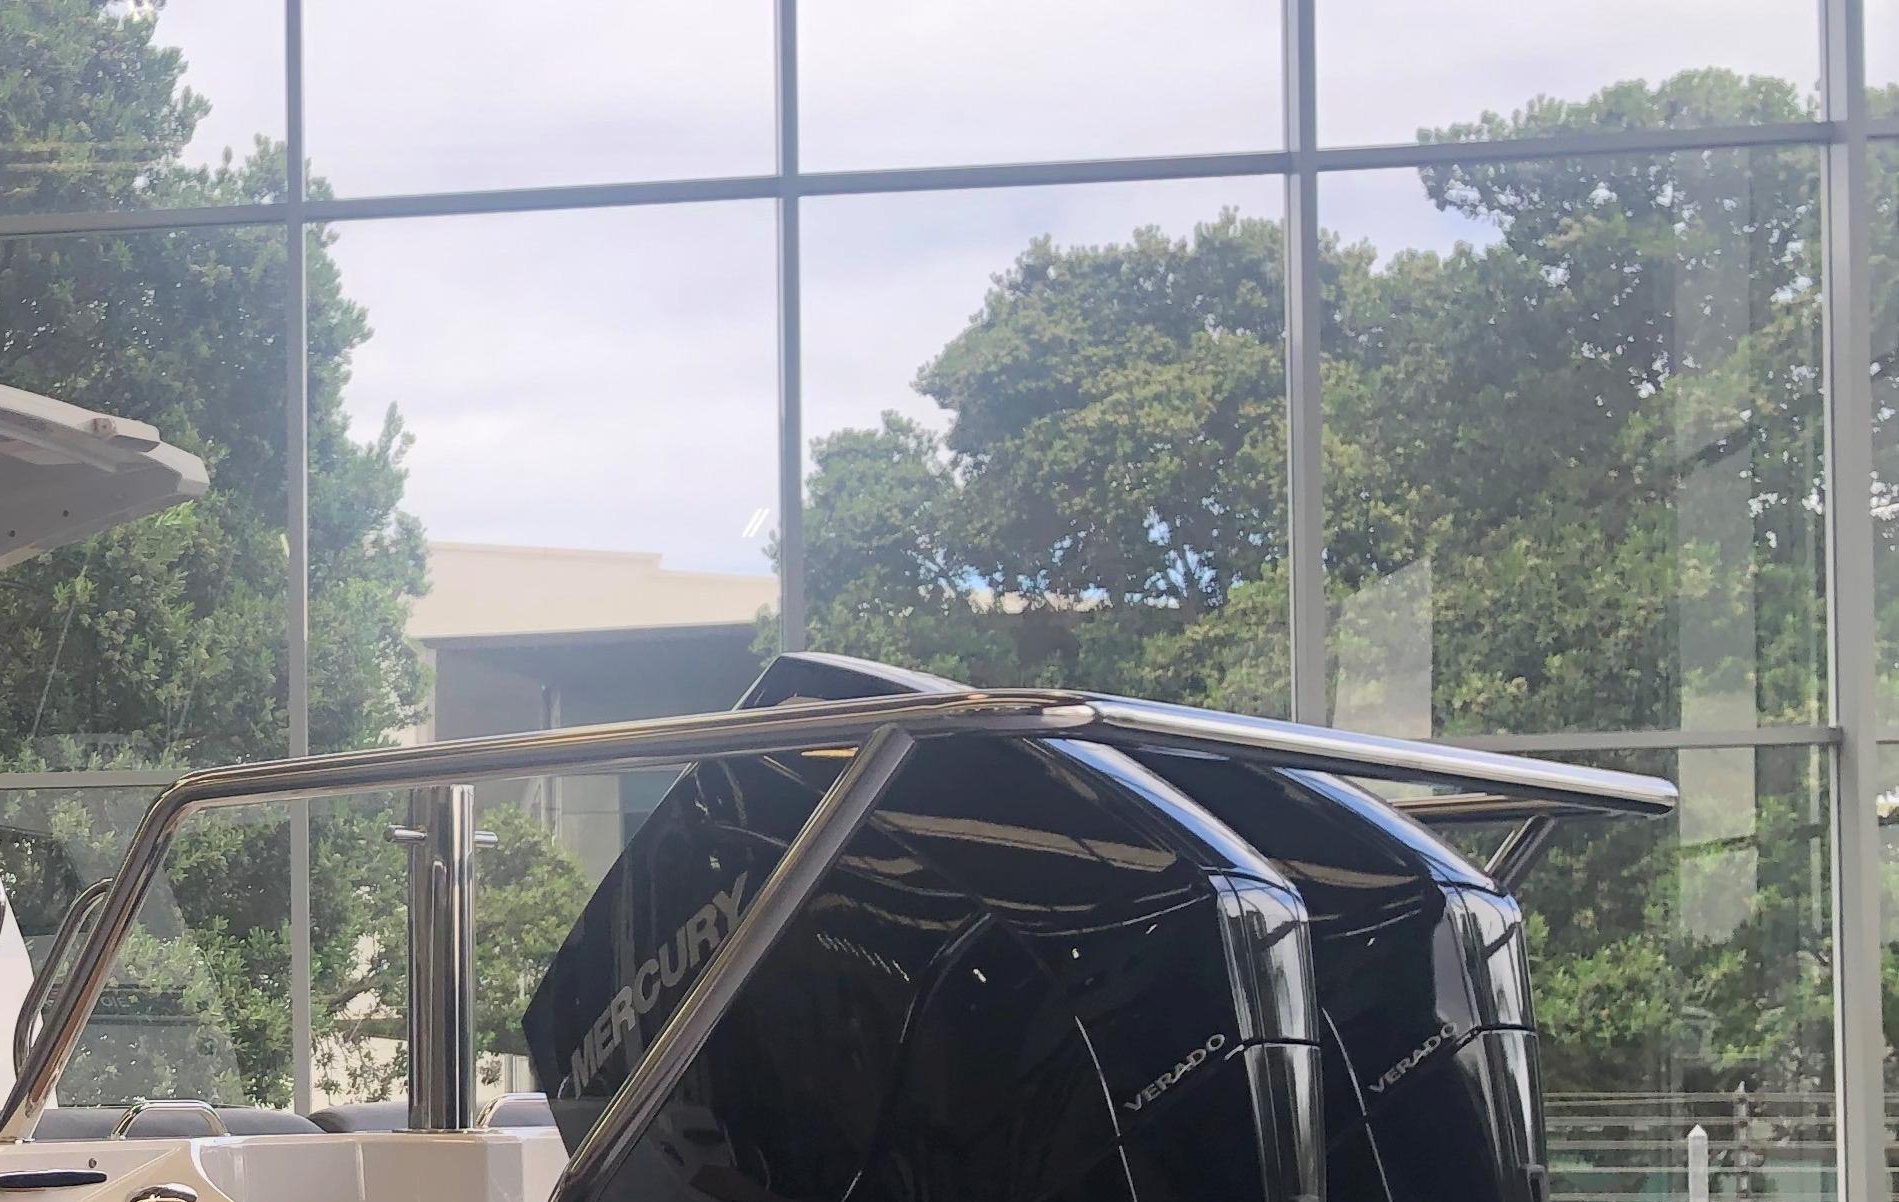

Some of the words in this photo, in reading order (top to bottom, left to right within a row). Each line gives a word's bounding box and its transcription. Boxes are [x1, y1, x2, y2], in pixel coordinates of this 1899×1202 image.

[571, 870, 748, 1100] MERCURY
[1124, 1033, 1226, 1112] VERADO
[1368, 1021, 1459, 1093] VERADO
